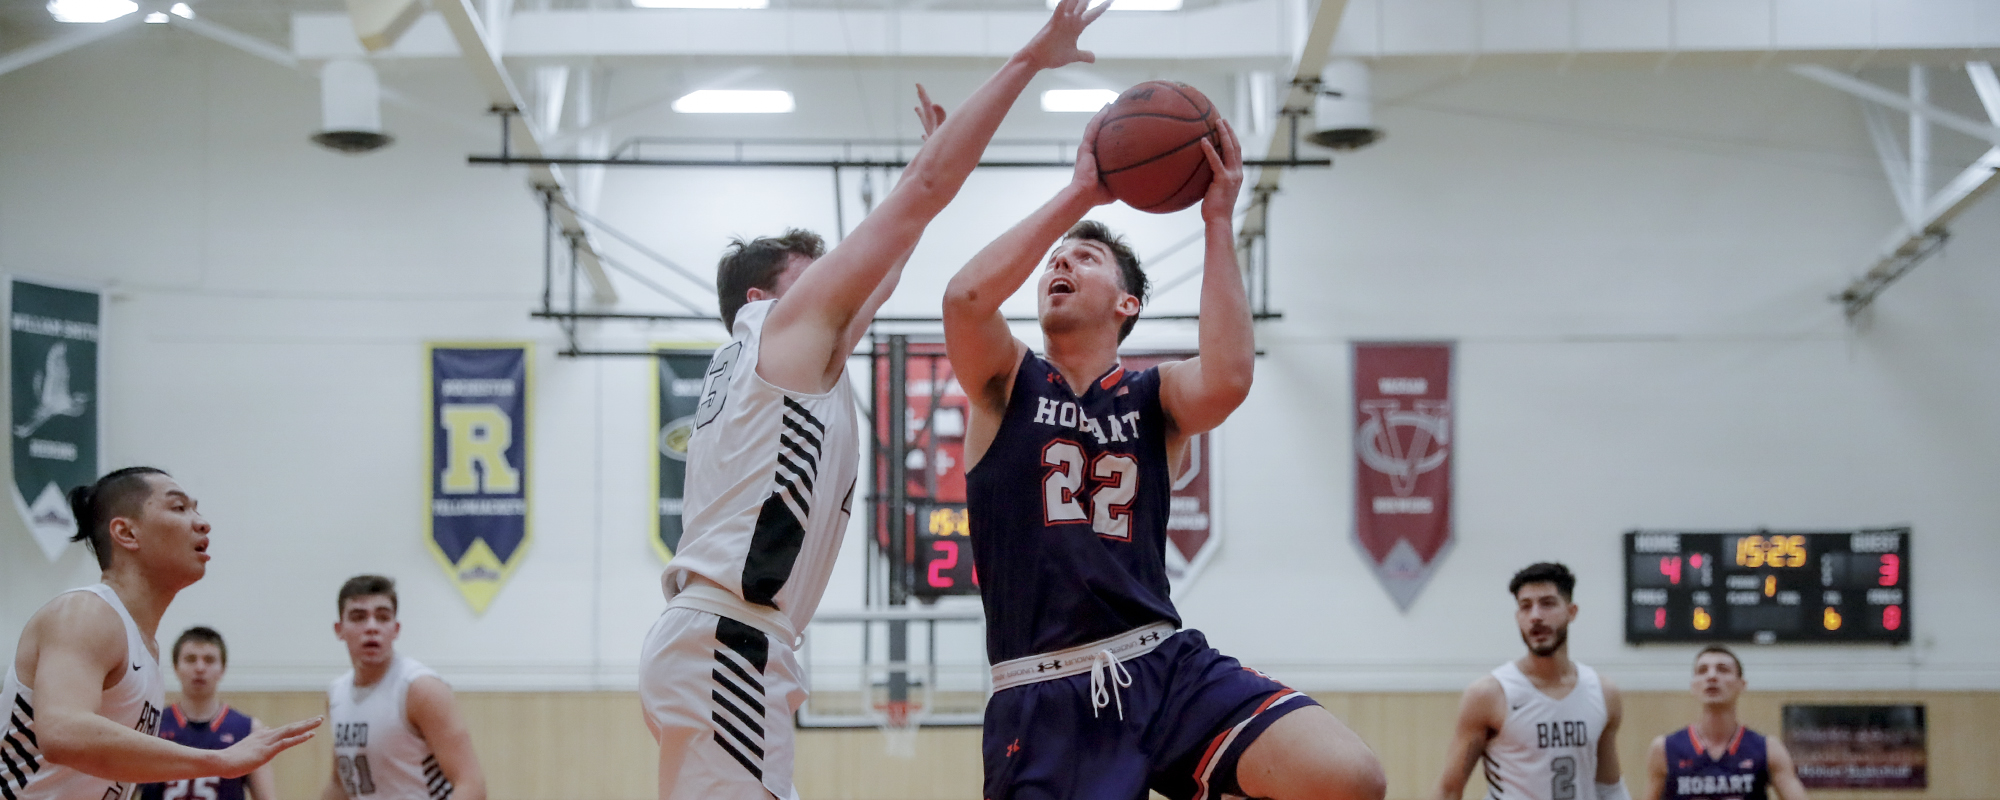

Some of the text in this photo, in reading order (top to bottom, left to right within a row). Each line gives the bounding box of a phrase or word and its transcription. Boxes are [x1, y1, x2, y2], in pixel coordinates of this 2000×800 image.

[1033, 396, 1141, 445] HOBART
[440, 403, 520, 495] R
[1040, 437, 1140, 543] 22
[1736, 534, 1807, 568] 15:25
[1659, 555, 1682, 585] 4
[1877, 553, 1900, 587] 3
[1536, 720, 1588, 749] BARD
[1551, 756, 1576, 800] 2
[1676, 773, 1755, 795] HOBART
